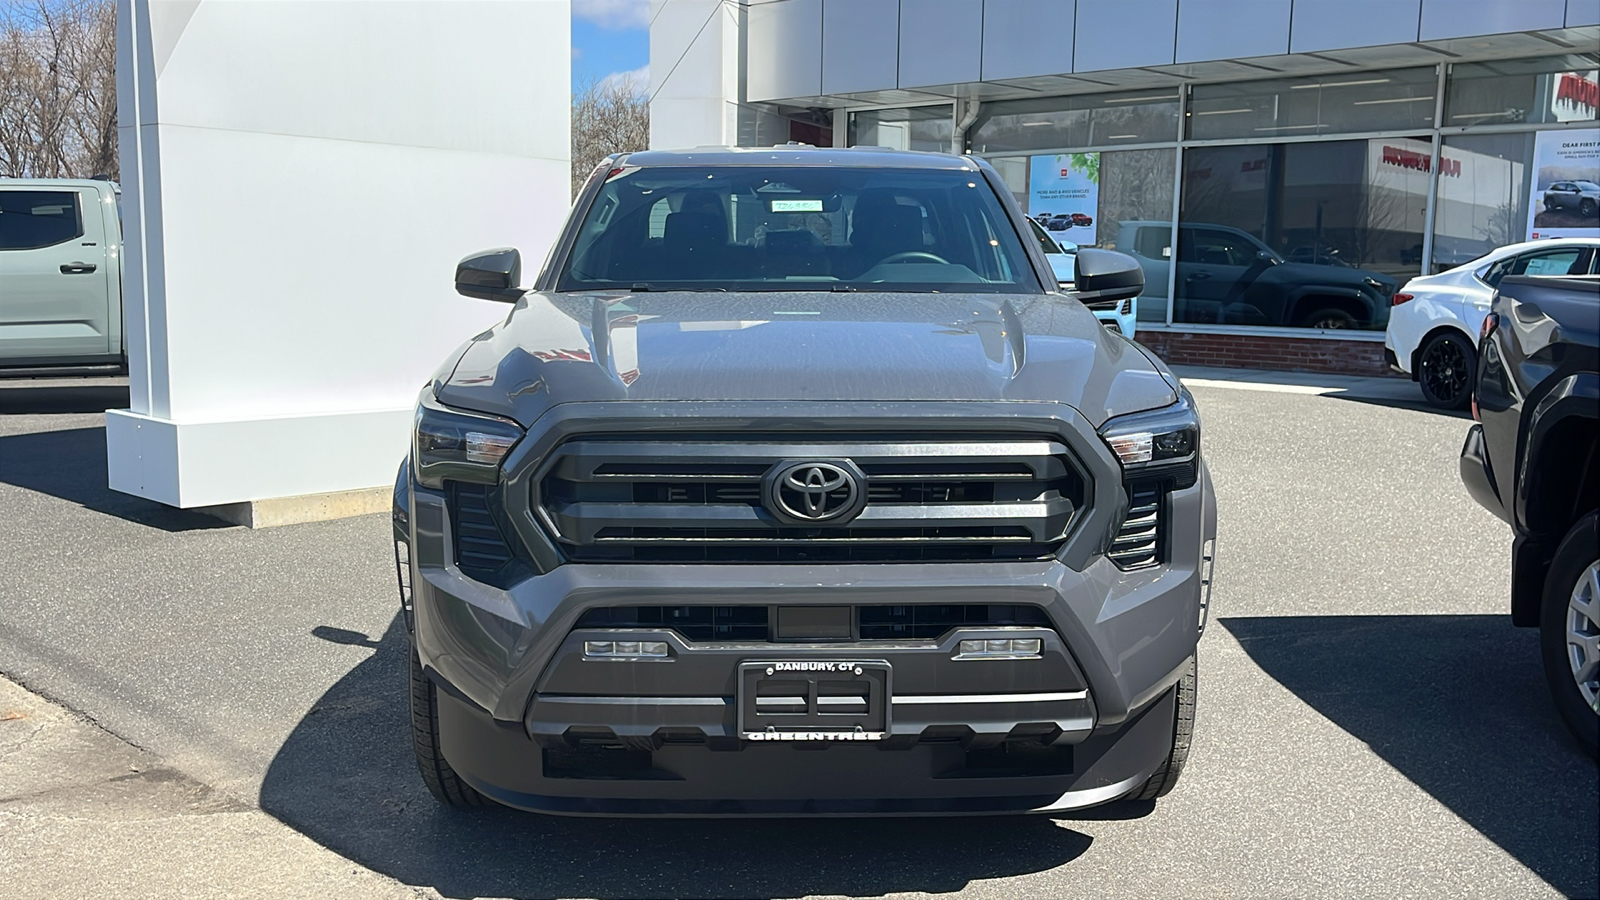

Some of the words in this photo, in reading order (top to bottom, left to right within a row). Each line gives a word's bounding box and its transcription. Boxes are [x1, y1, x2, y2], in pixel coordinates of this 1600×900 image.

[775, 662, 835, 671] DANBURY,
[838, 662, 856, 671] CT
[748, 732, 882, 741] GREENTREE
